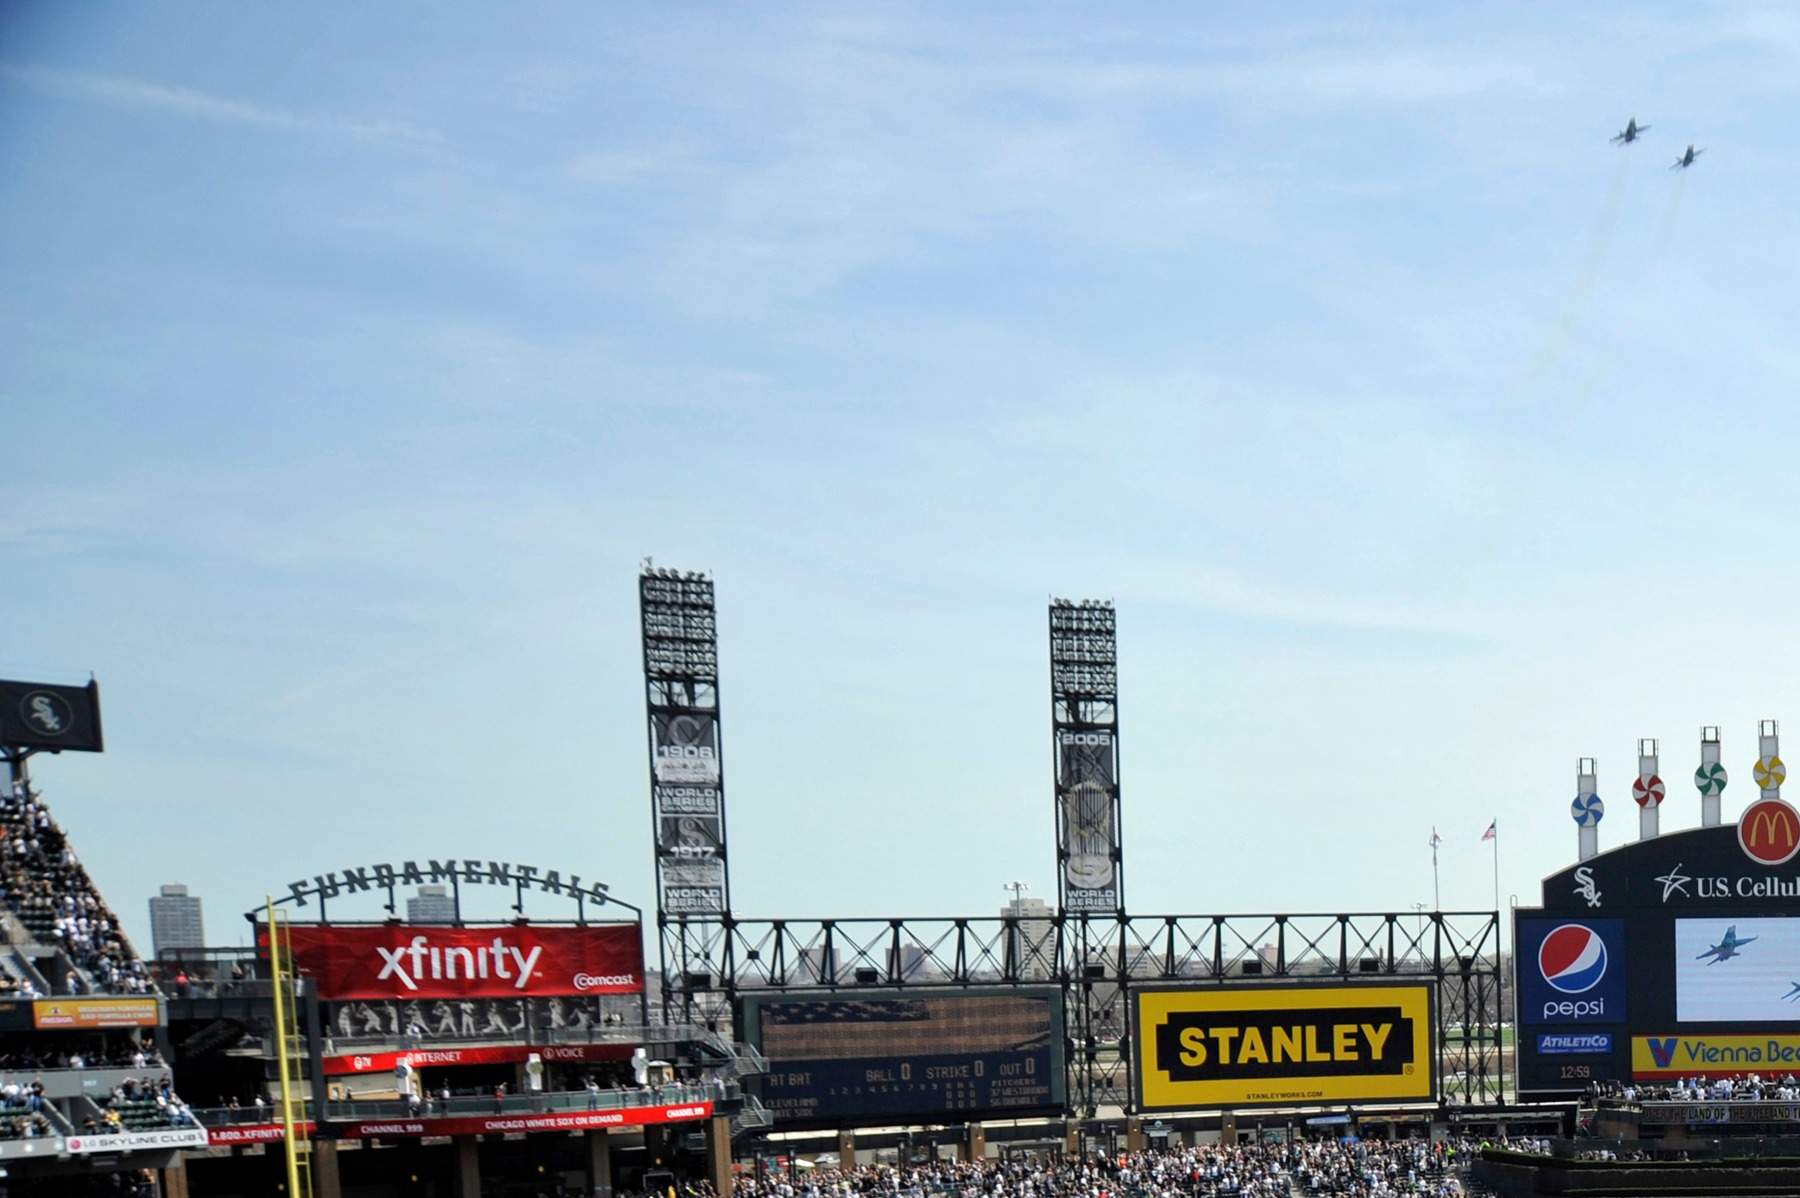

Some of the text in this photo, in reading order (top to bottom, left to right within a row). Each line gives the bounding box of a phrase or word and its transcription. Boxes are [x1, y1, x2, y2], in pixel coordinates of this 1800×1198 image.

[1062, 734, 1111, 745] 2005
[661, 788, 715, 797] WORLD
[661, 797, 715, 806] SERIES
[670, 847, 715, 858] 1917
[287, 860, 609, 907] FUNDAMENTALS
[1697, 878, 1731, 897] U.S.
[667, 889, 719, 898] WORLD
[1067, 890, 1115, 898] WORLD
[376, 936, 541, 990] xfinity
[1544, 997, 1604, 1019] pepsi
[1179, 1023, 1392, 1067] STANLEY
[555, 1048, 584, 1058] VOICE
[1684, 1040, 1762, 1063] Vienna
[866, 1058, 1035, 1082] BALL 0 STRIKE 0 OUT 0
[1560, 1067, 1590, 1079] 12:59
[789, 1073, 812, 1085] BAT
[1688, 1108, 1713, 1119] LAND
[1714, 1107, 1727, 1119] OF
[361, 1125, 404, 1134] CHANNEL
[485, 1120, 525, 1129] CHICAGO
[527, 1119, 556, 1128] WHITE
[557, 1117, 574, 1126] SOX
[575, 1117, 588, 1125] ON
[589, 1114, 623, 1124] DEMAND
[99, 1135, 151, 1146] SKYLINE
[156, 1134, 196, 1143] CLUB
